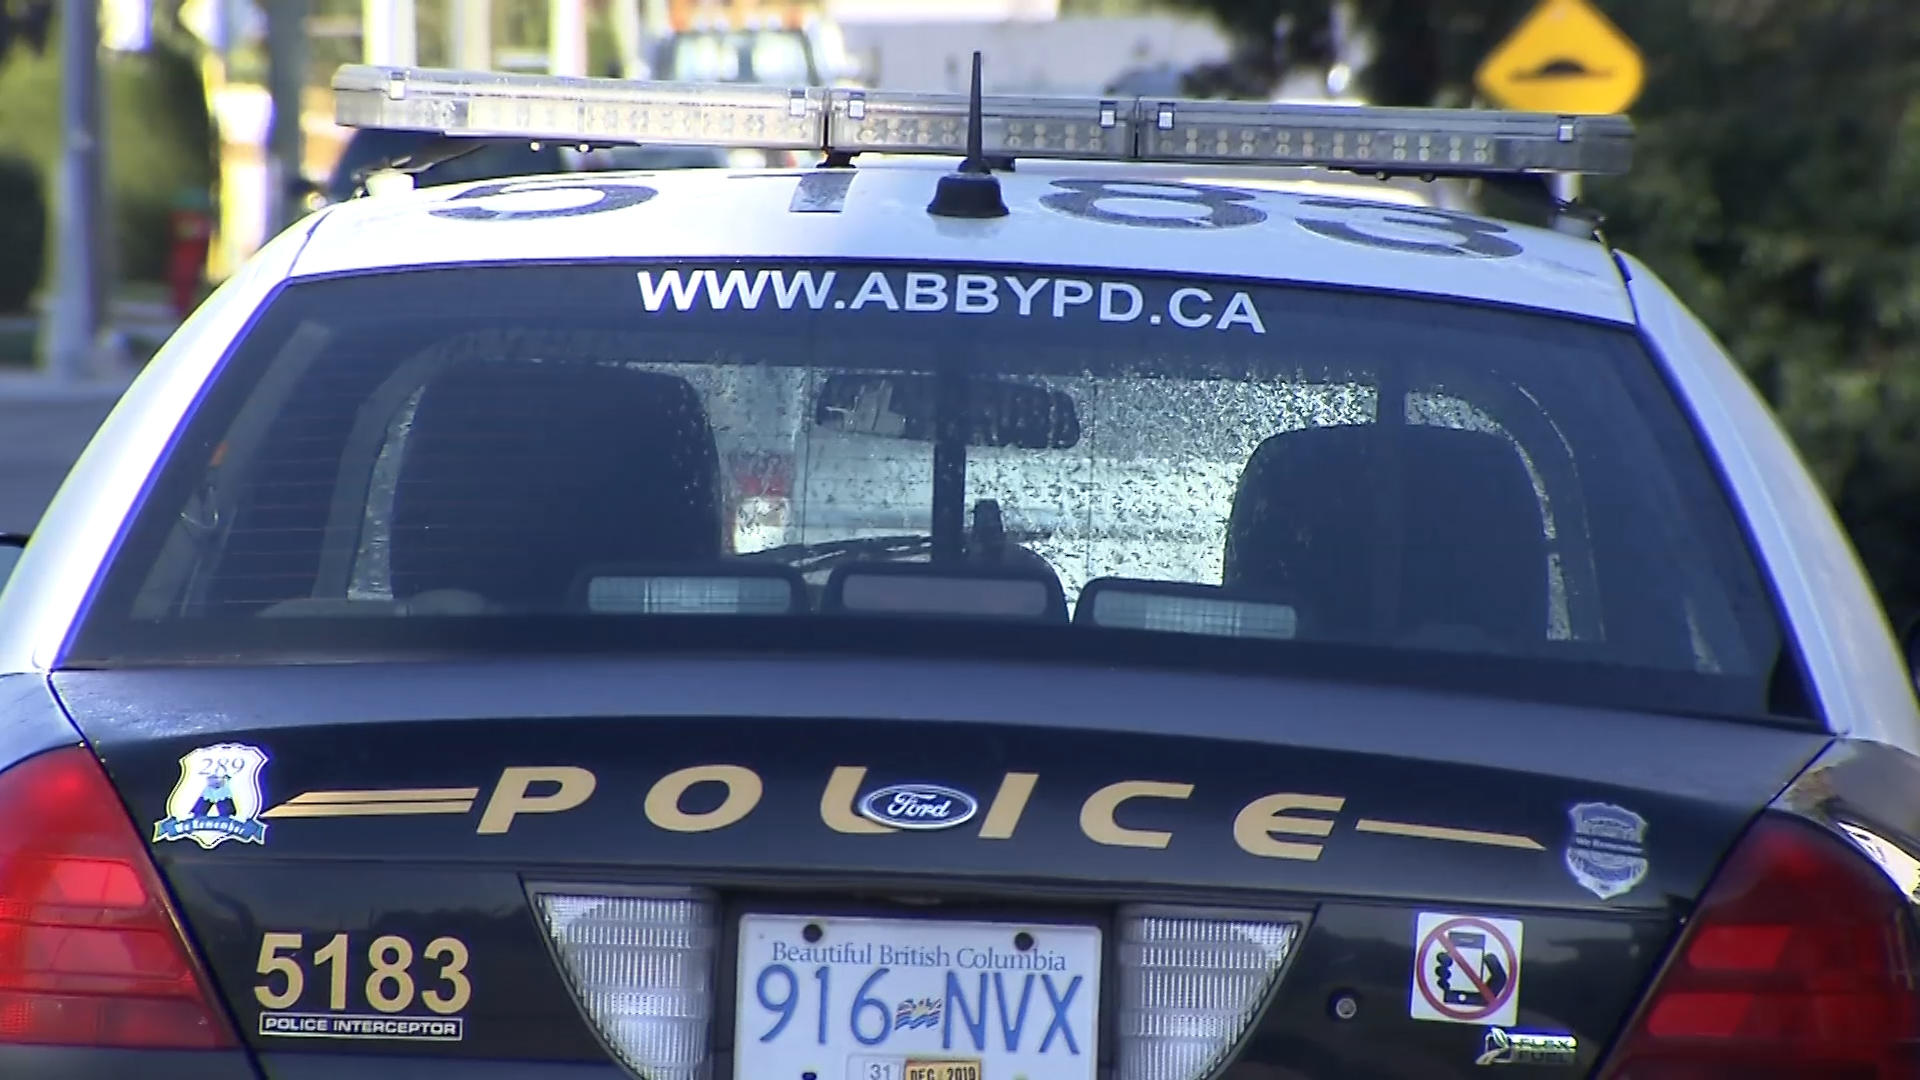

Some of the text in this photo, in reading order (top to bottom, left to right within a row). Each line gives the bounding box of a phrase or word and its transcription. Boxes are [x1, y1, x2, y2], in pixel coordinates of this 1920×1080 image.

[638, 270, 1265, 333] WWW.ABBYPD.CA
[198, 757, 245, 776] 289
[476, 764, 1346, 860] POLICE
[887, 791, 951, 820] Ford
[772, 941, 1067, 971] Beautiful British Columbia
[254, 932, 471, 1014] 5183
[756, 964, 1083, 1055] 916 NVX
[265, 1018, 456, 1034] POLICE INTERCEPTOR
[870, 1064, 891, 1080] 31
